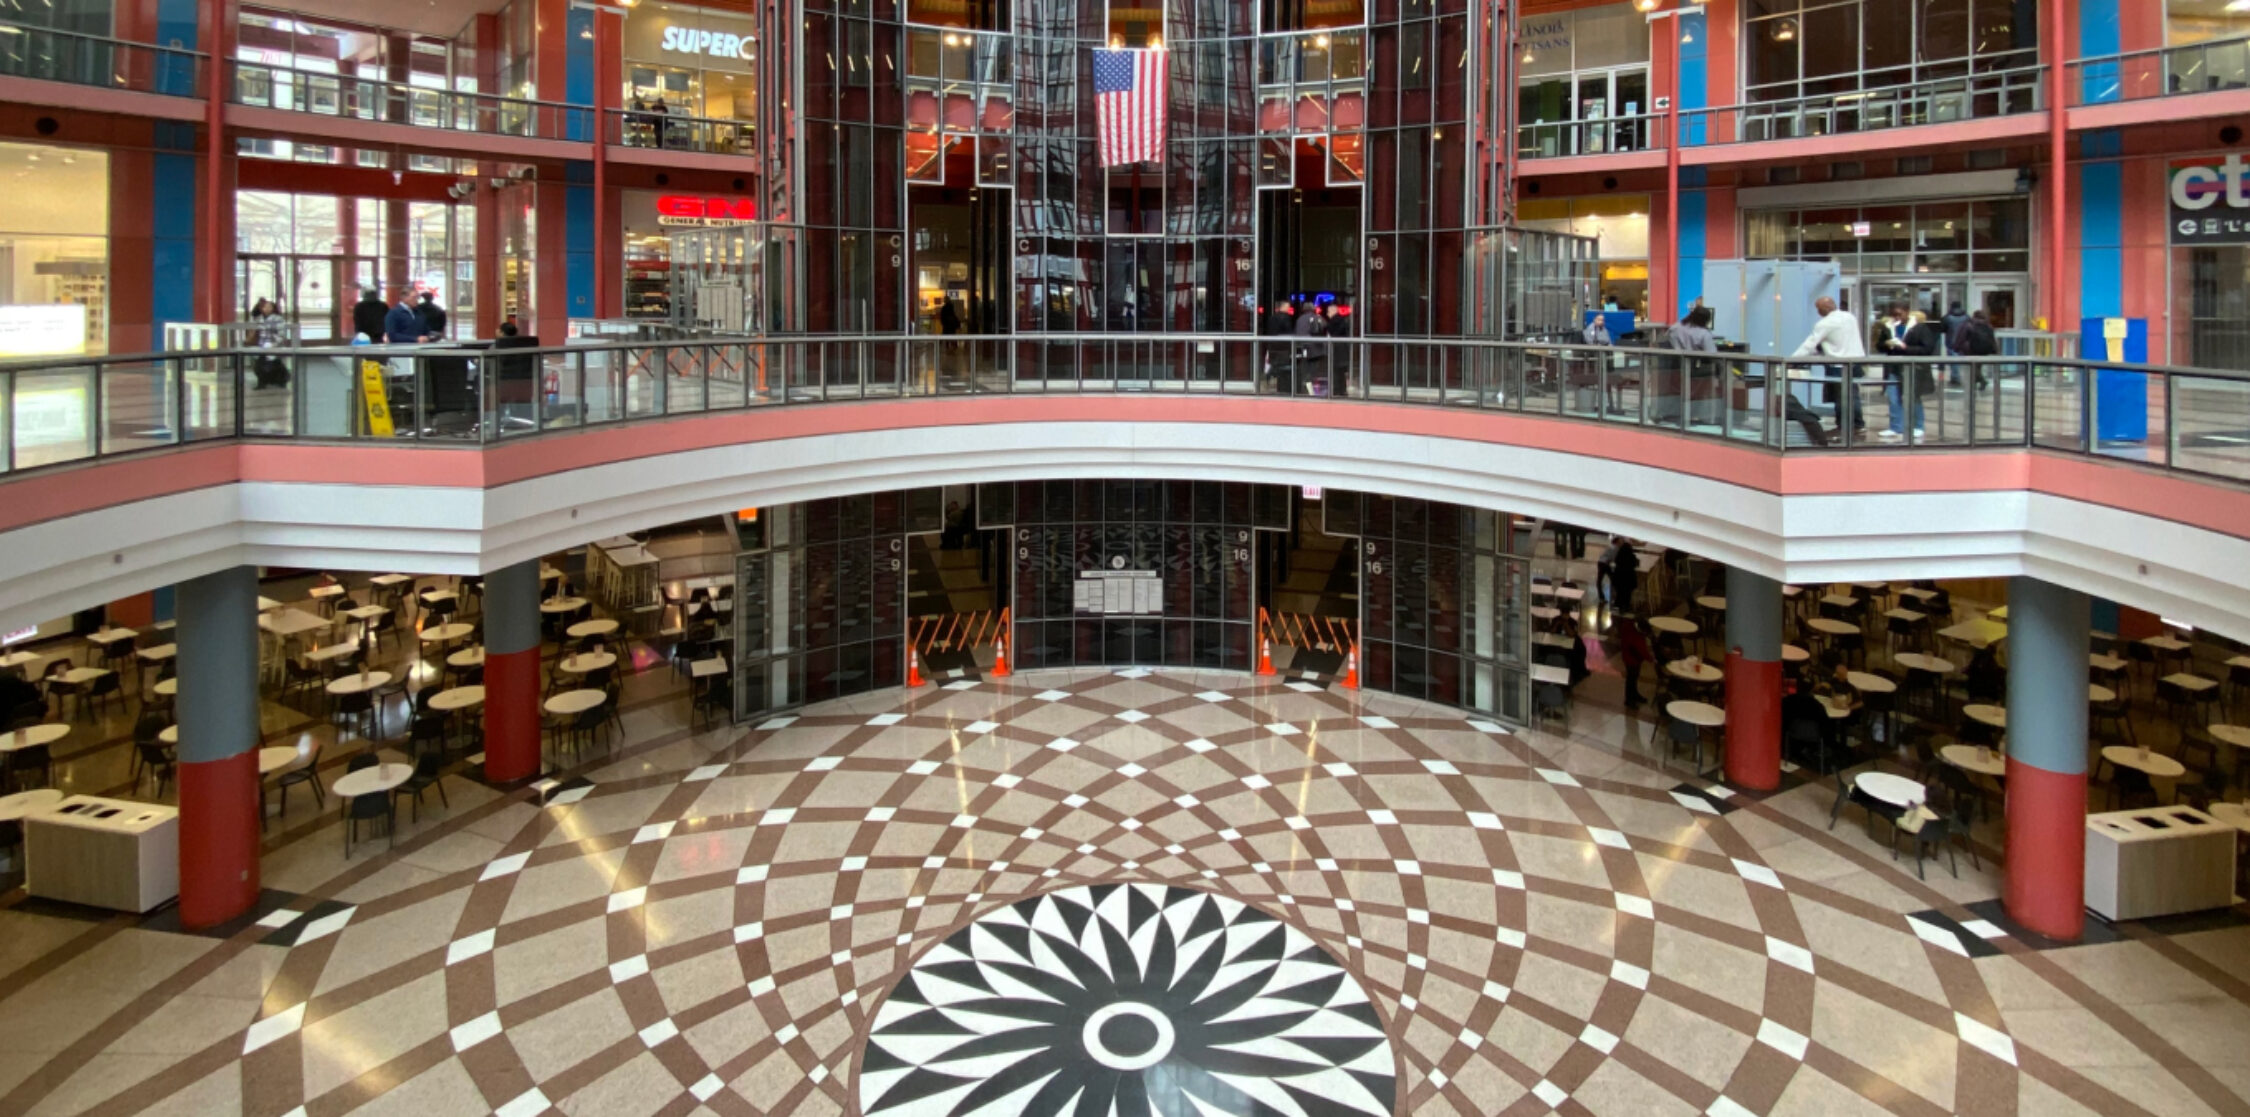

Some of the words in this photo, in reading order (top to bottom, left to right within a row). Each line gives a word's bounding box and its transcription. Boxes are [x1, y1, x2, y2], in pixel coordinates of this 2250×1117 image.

[661, 25, 756, 60] SUPERC
[656, 194, 756, 220] GN
[663, 217, 705, 225] GENERAL
[890, 235, 900, 248] C
[1019, 239, 1029, 251] C
[1241, 240, 1250, 252] 9
[1368, 238, 1378, 250] 9
[891, 255, 900, 267] 9
[1235, 259, 1251, 271] 16
[1368, 257, 1384, 270] 16
[1019, 529, 1029, 541] C
[1238, 530, 1248, 542] 9
[890, 539, 900, 551] C
[1366, 542, 1375, 555] 9
[1019, 547, 1029, 559] 9
[1233, 548, 1249, 561] 16
[890, 558, 900, 571] 9
[1366, 561, 1381, 574] 16
